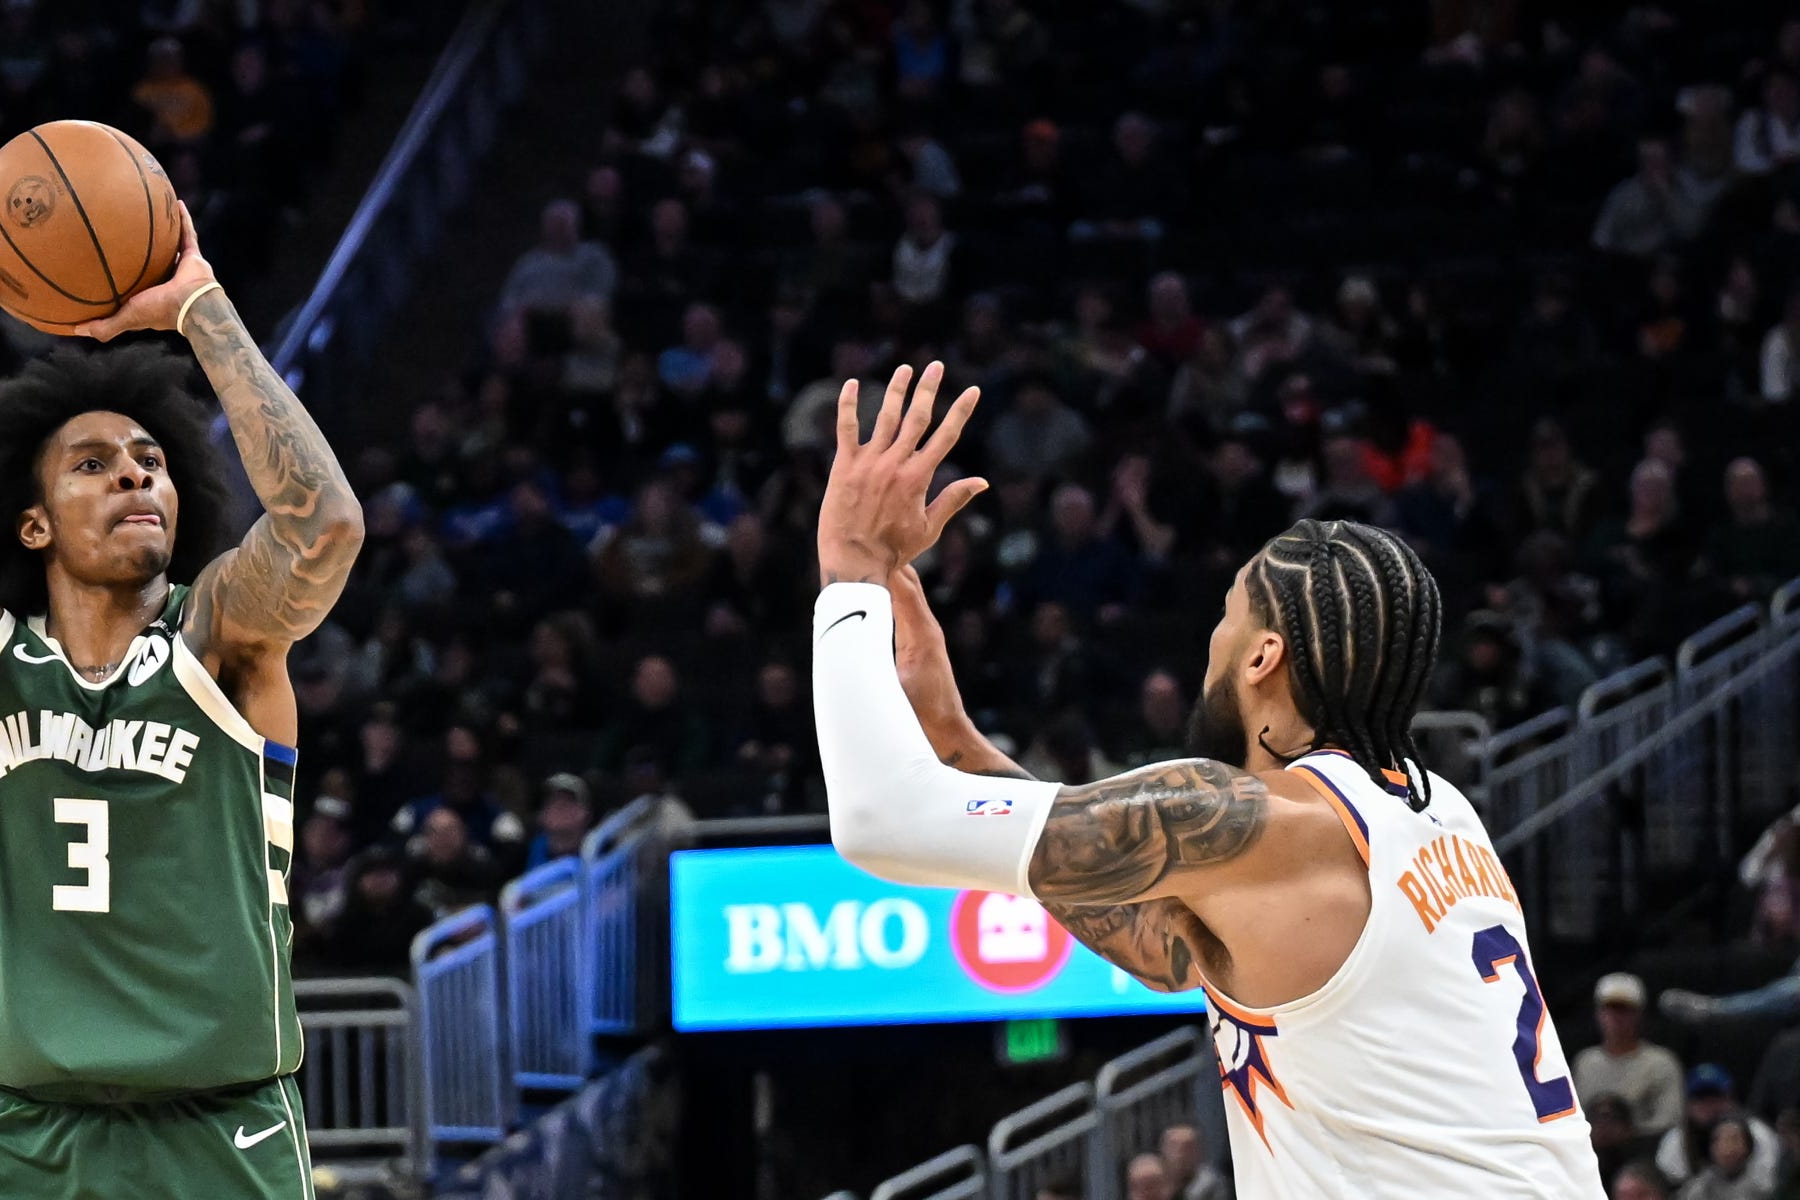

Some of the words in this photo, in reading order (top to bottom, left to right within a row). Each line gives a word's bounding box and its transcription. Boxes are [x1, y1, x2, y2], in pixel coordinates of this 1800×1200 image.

[52, 797, 110, 913] 3
[723, 897, 930, 974] BMO
[1471, 923, 1577, 1124] 2
